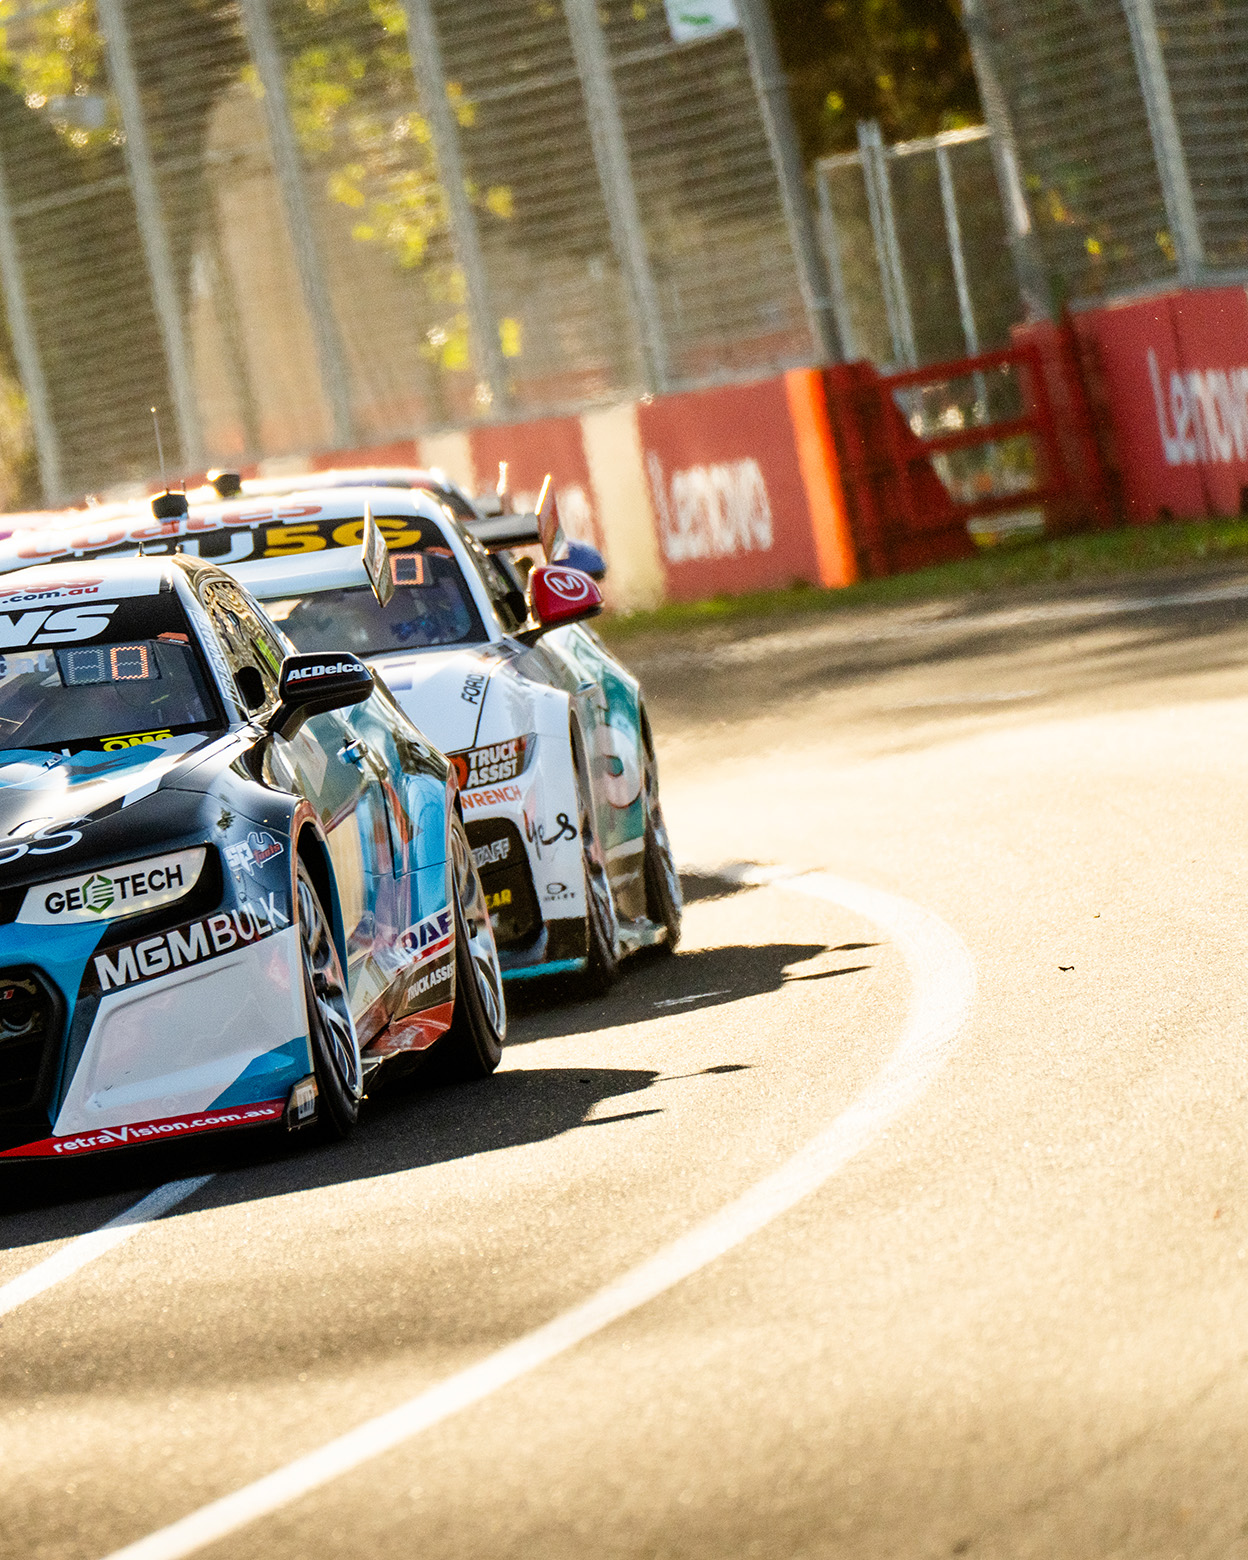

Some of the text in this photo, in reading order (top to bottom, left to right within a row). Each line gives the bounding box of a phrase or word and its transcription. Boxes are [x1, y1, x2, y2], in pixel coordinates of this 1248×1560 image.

[286, 662, 364, 682] ACDelco
[468, 739, 518, 769] TRUCK
[466, 758, 518, 788] ASSIST
[471, 837, 510, 868] TAFF
[53, 1107, 276, 1153] retraVision.com.au
